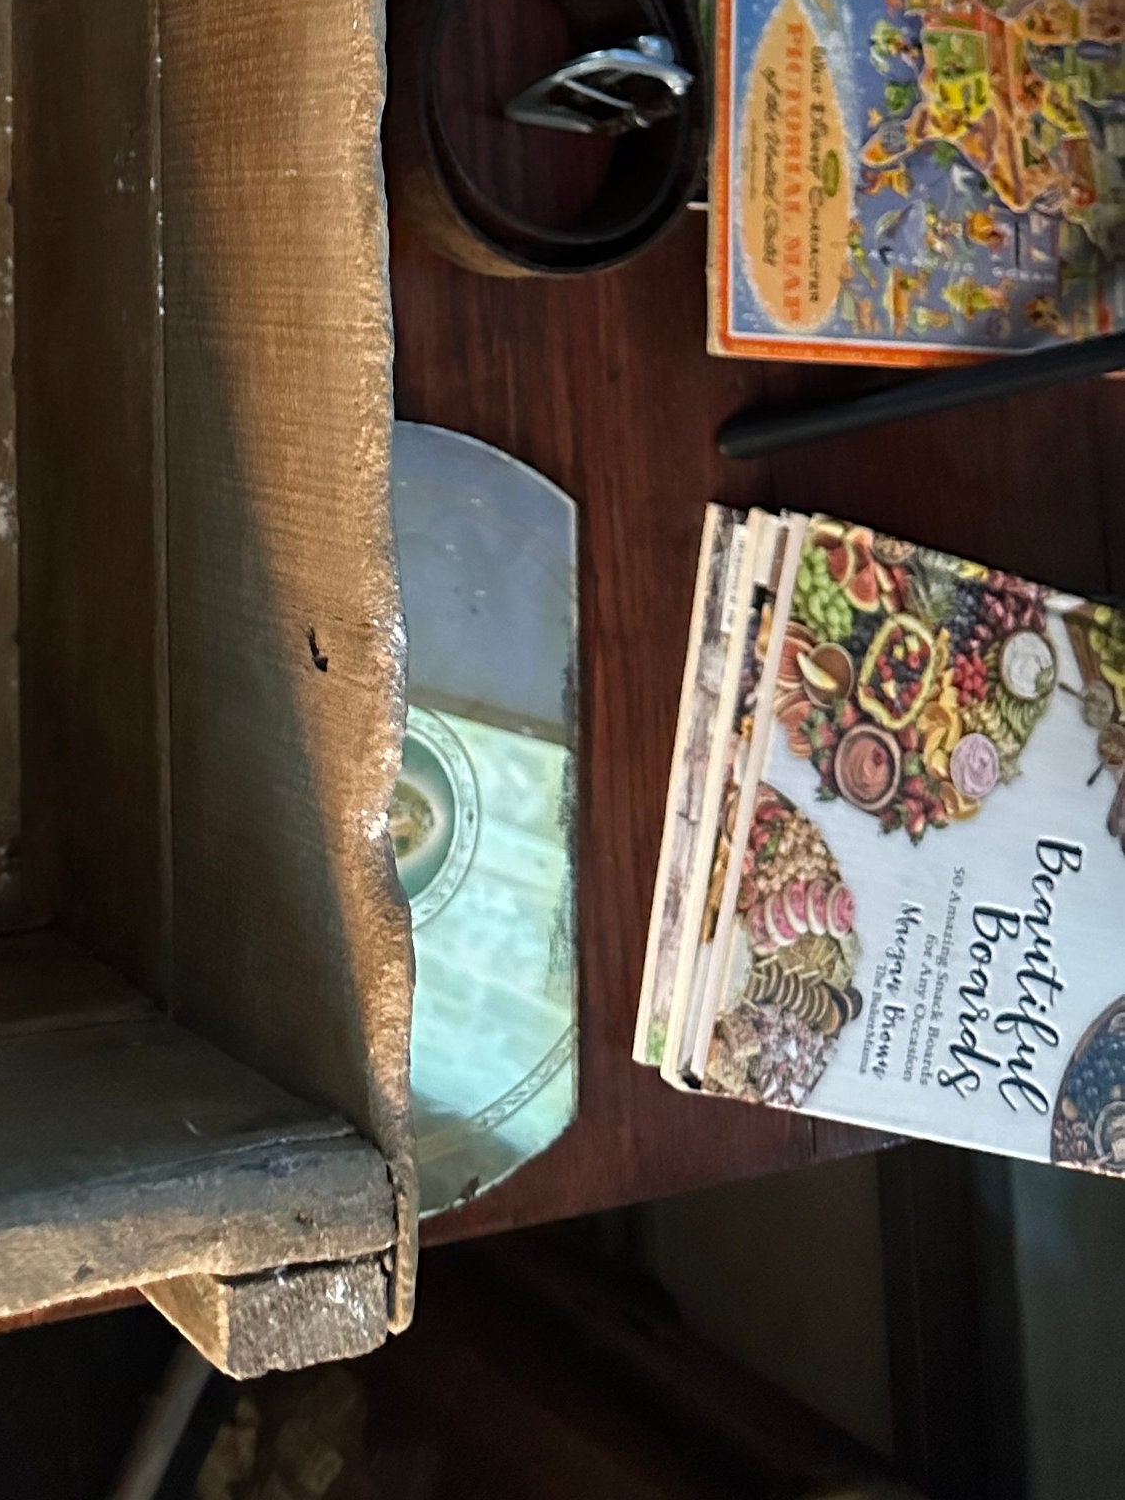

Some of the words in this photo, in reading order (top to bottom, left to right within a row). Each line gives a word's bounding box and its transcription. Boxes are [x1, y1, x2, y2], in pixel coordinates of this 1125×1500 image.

[784, 21, 805, 222] PICTORIAL
[783, 236, 801, 322] MAP
[952, 866, 966, 887] 50
[885, 905, 921, 996] Maegan
[922, 933, 939, 958] for
[935, 891, 964, 968] Amazing
[872, 962, 889, 988] The
[913, 966, 935, 1000] Any
[928, 971, 949, 1022] Snack
[937, 905, 1022, 1099] Boards
[994, 840, 1082, 1115] Beautiful
[873, 1006, 906, 1080] Brown
[902, 1003, 927, 1083] Occasion
[919, 1026, 941, 1086] Boards
